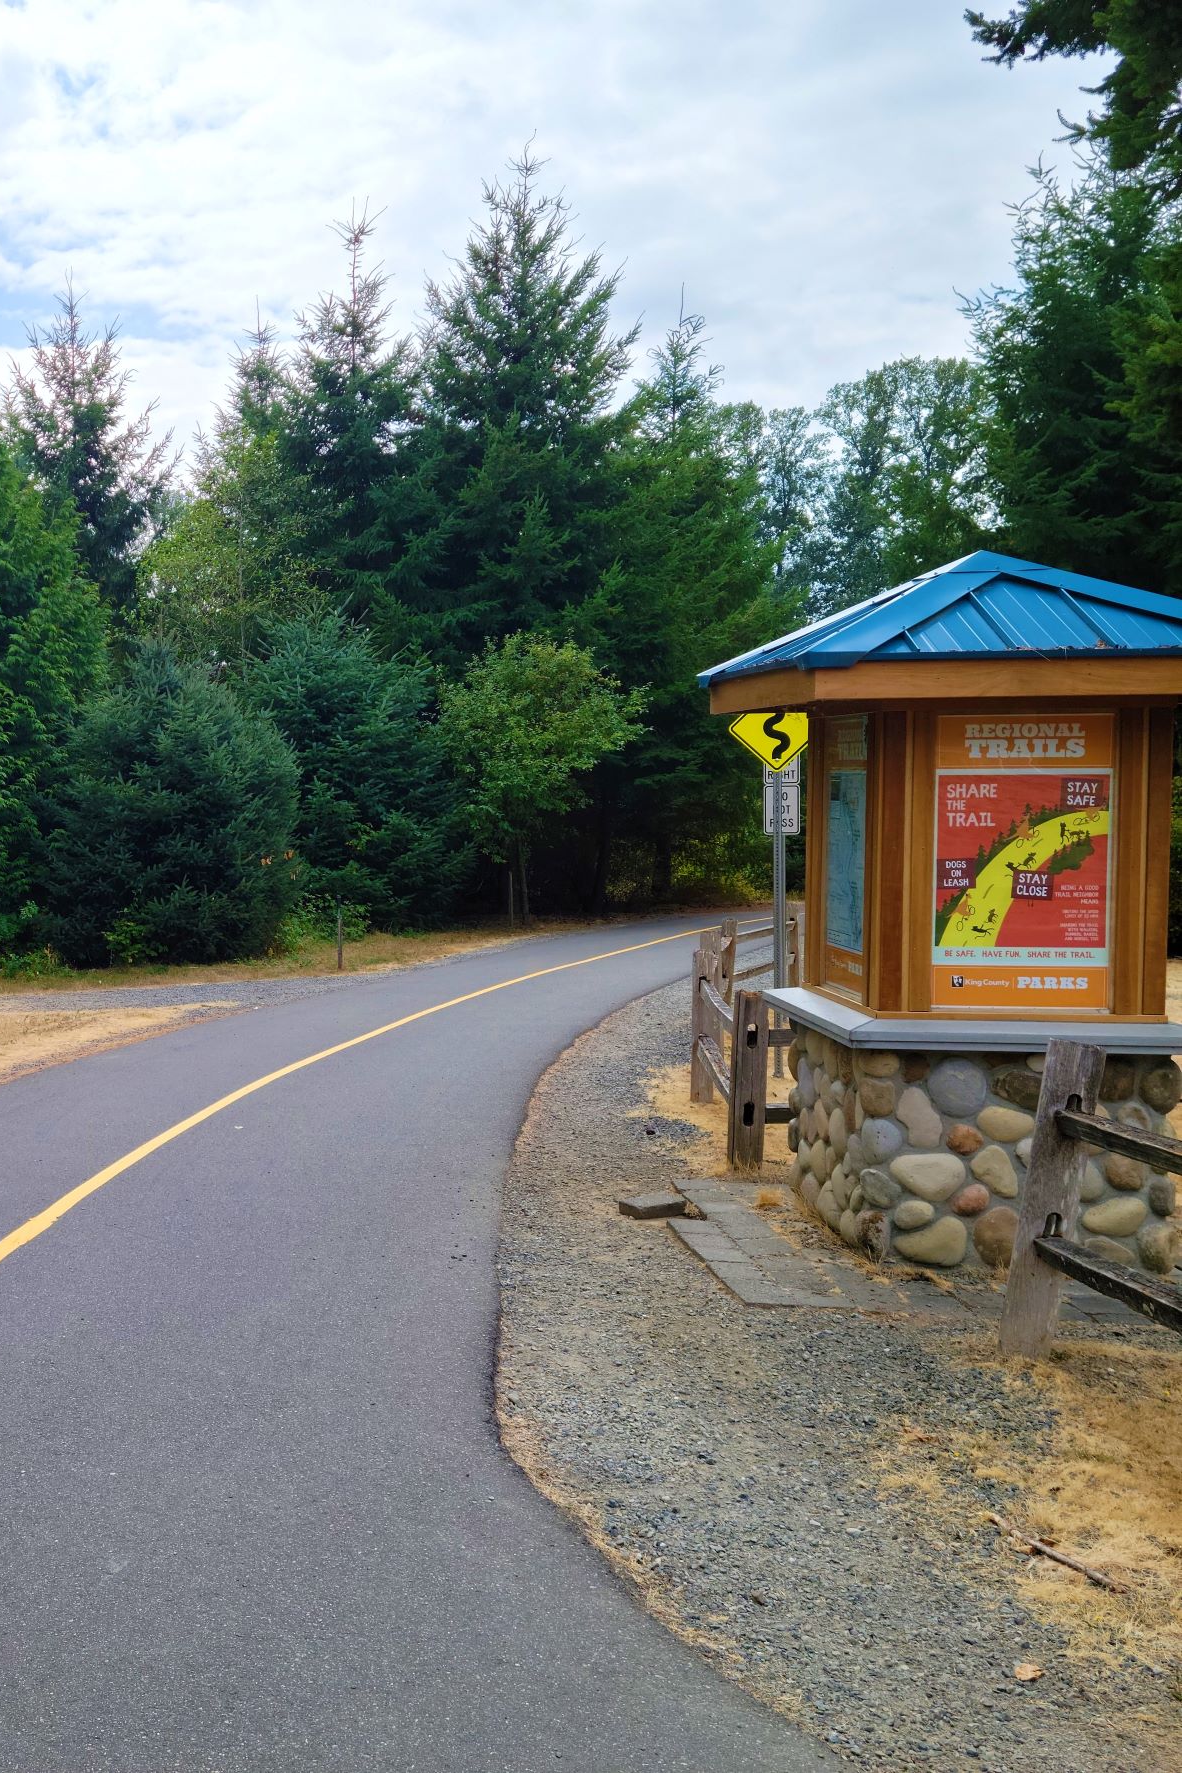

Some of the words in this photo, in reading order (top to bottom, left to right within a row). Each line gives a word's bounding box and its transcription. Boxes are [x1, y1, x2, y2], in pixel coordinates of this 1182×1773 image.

[965, 723, 1085, 737] REGIONAL
[965, 738, 1085, 758] TRAILS
[767, 770, 795, 779] RHT
[946, 783, 998, 798] SHARE
[1067, 781, 1098, 794] STAY
[946, 800, 966, 810] THE
[1066, 795, 1096, 806] SAFE
[773, 805, 791, 814] OT
[769, 818, 794, 828] PSS
[946, 812, 996, 827] TRAIL
[951, 869, 962, 877] ON
[943, 879, 969, 887] LEASH
[1018, 873, 1048, 885] STAY
[1016, 885, 1048, 897] CLOSE
[956, 950, 976, 958] SAFE.
[982, 950, 1003, 958] HAVE
[1070, 951, 1095, 959] TRAIL.
[1017, 976, 1088, 989] PARKS
